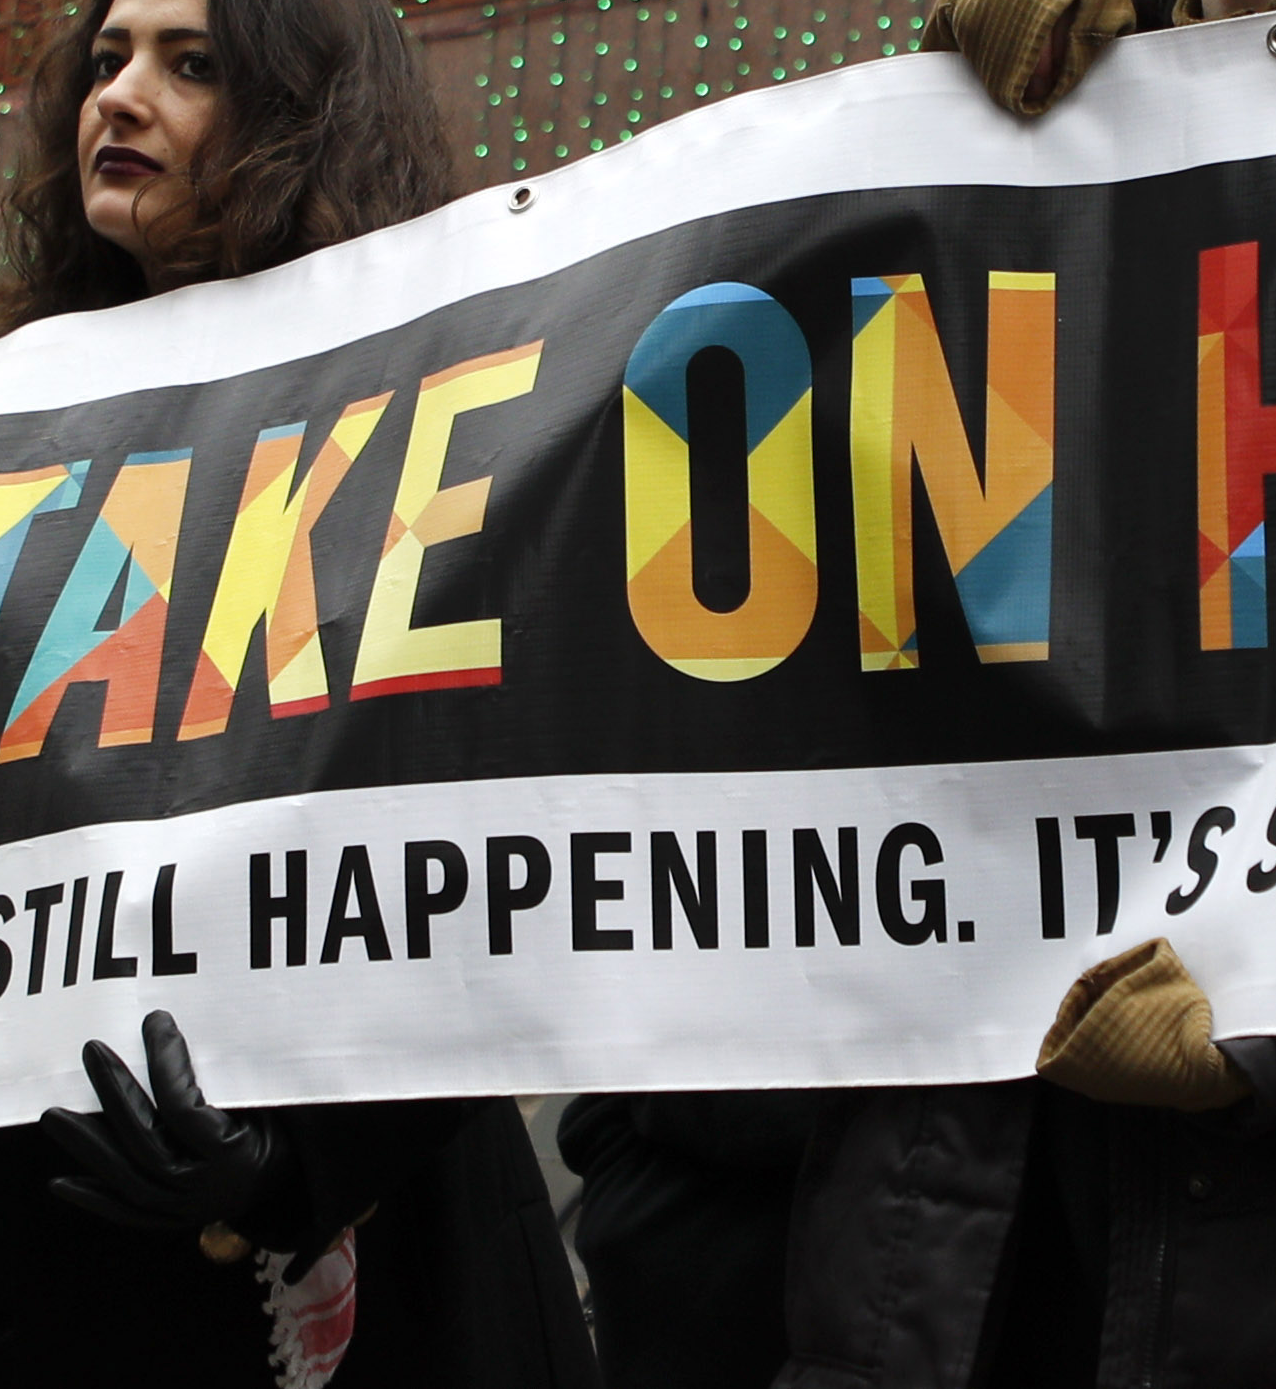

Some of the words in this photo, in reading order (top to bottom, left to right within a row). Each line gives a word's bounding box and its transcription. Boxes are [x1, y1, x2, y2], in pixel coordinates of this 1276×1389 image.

[623, 272, 1056, 683] ON
[248, 820, 976, 971] HAPPENING.
[1035, 805, 1236, 941] IT'S
